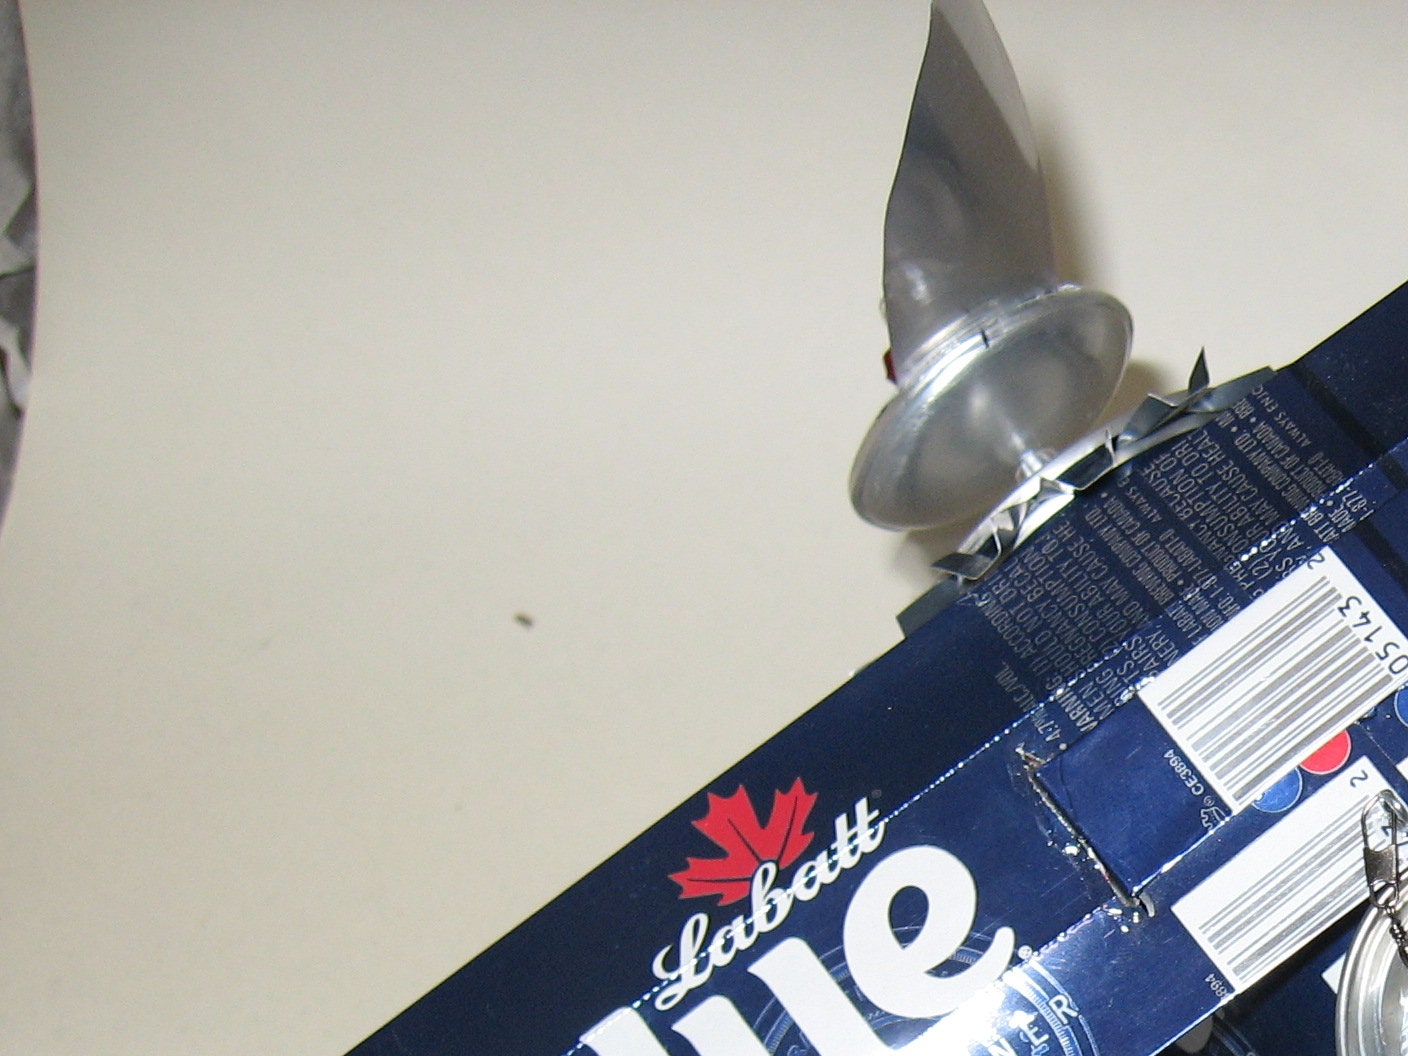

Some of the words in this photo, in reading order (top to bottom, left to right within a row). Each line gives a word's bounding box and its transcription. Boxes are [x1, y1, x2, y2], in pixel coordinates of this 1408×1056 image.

[1251, 418, 1290, 460] CANADA
[1274, 408, 1311, 450] ALWAYS
[1171, 437, 1200, 467] DRI
[1190, 460, 1214, 484] TO
[1247, 444, 1291, 492] COMPANY
[1217, 457, 1258, 502] CAUSE
[1102, 493, 1141, 536] CANADA
[1125, 484, 1162, 525] ALWAYS
[1205, 476, 1254, 530] ABILITY
[1249, 493, 1280, 526] MAY
[1051, 518, 1076, 543] HE
[1067, 535, 1109, 580] CAUSE
[986, 571, 1018, 604] DRI
[1018, 542, 1107, 645] CONSUMPTION
[1056, 554, 1105, 608] ABILITY
[1099, 573, 1131, 606] MAY
[1008, 598, 1042, 633] NOT
[1096, 601, 1133, 641] YOUR
[1122, 598, 1152, 630] AND
[1162, 746, 1206, 798] CE3894
[1347, 769, 1369, 788] 2
[651, 795, 886, 1012] Labatt
